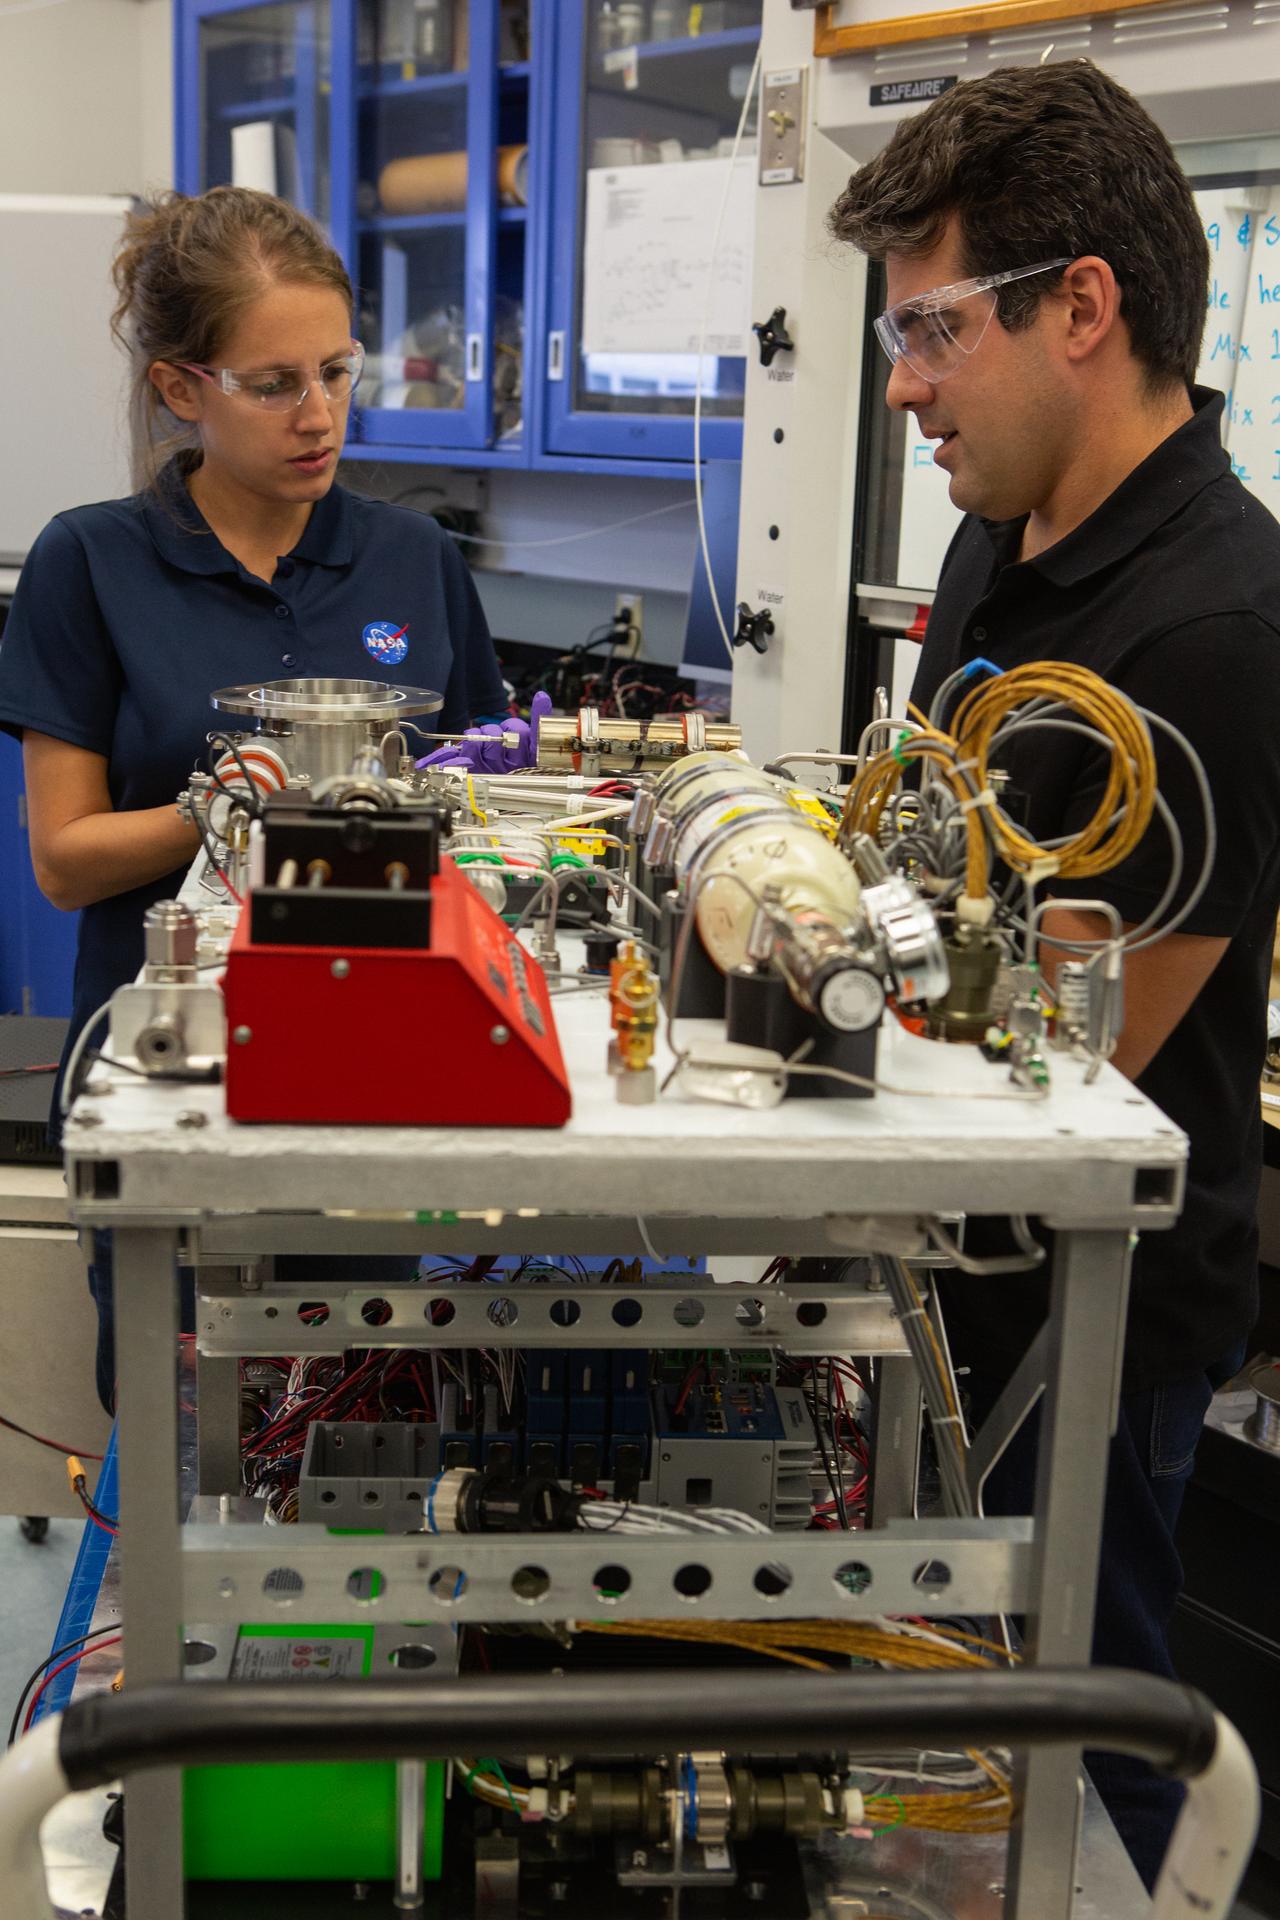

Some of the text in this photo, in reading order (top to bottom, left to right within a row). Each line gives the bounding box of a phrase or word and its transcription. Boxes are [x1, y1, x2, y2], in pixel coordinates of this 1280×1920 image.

[880, 80, 941, 101] SAFEAIRE
[1210, 333, 1252, 362] Mix
[767, 369, 794, 382] Water
[757, 589, 784, 604] Water
[366, 637, 406, 650] NASA
